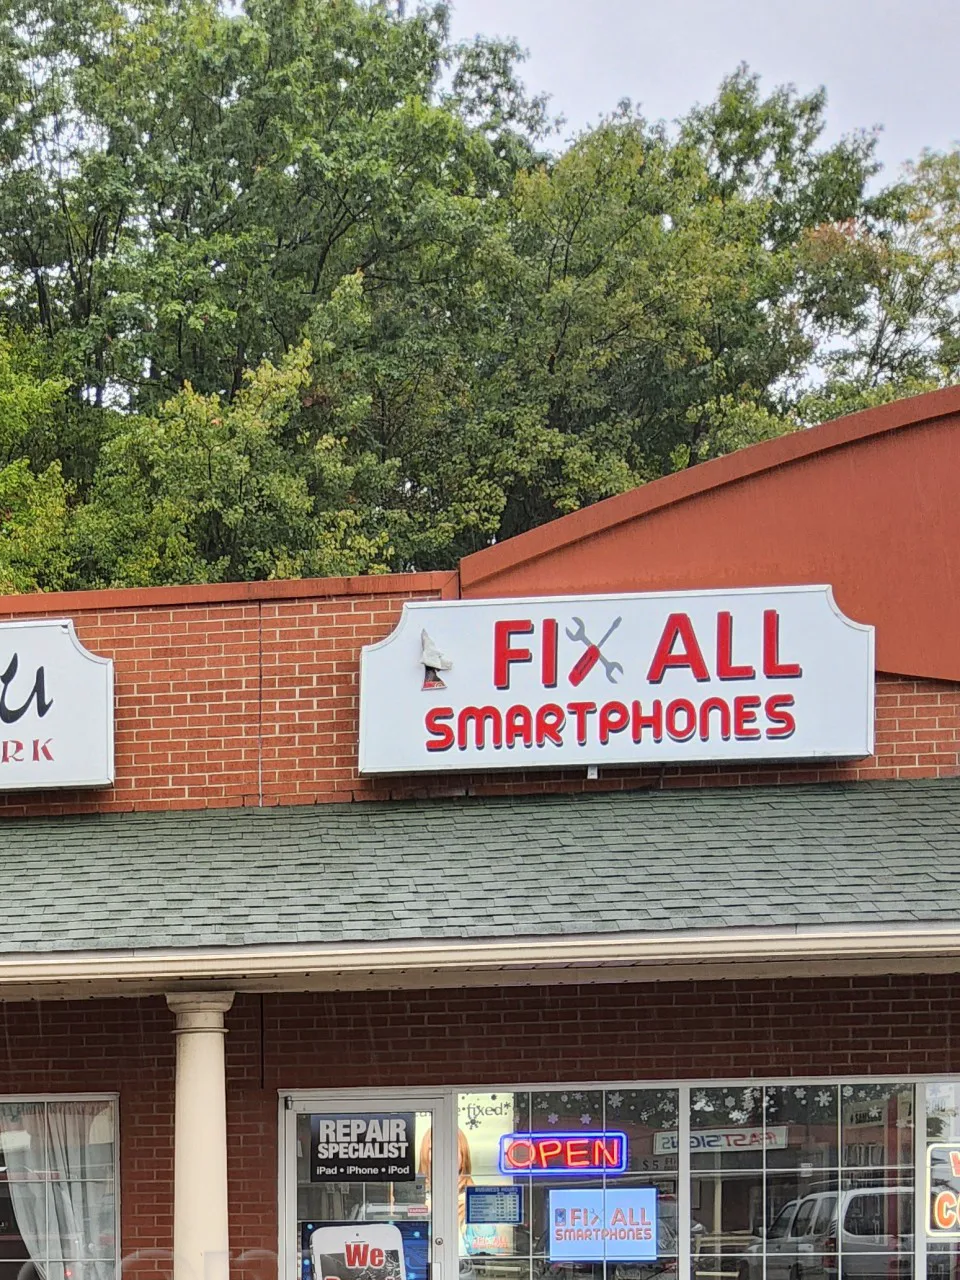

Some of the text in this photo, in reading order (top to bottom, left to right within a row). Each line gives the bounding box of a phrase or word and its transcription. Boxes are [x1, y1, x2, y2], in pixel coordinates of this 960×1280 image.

[646, 609, 803, 684] ALL
[424, 693, 797, 752] SMARTPHONES
[319, 1118, 407, 1142] REPAIR
[317, 1142, 409, 1159] SPECIALIST
[505, 1137, 620, 1168] OPEN
[316, 1165, 410, 1175] iPad iPhone iPod
[611, 1207, 652, 1226] ALL
[555, 1227, 652, 1241] SMARTPHONES
[345, 1243, 385, 1268] We
